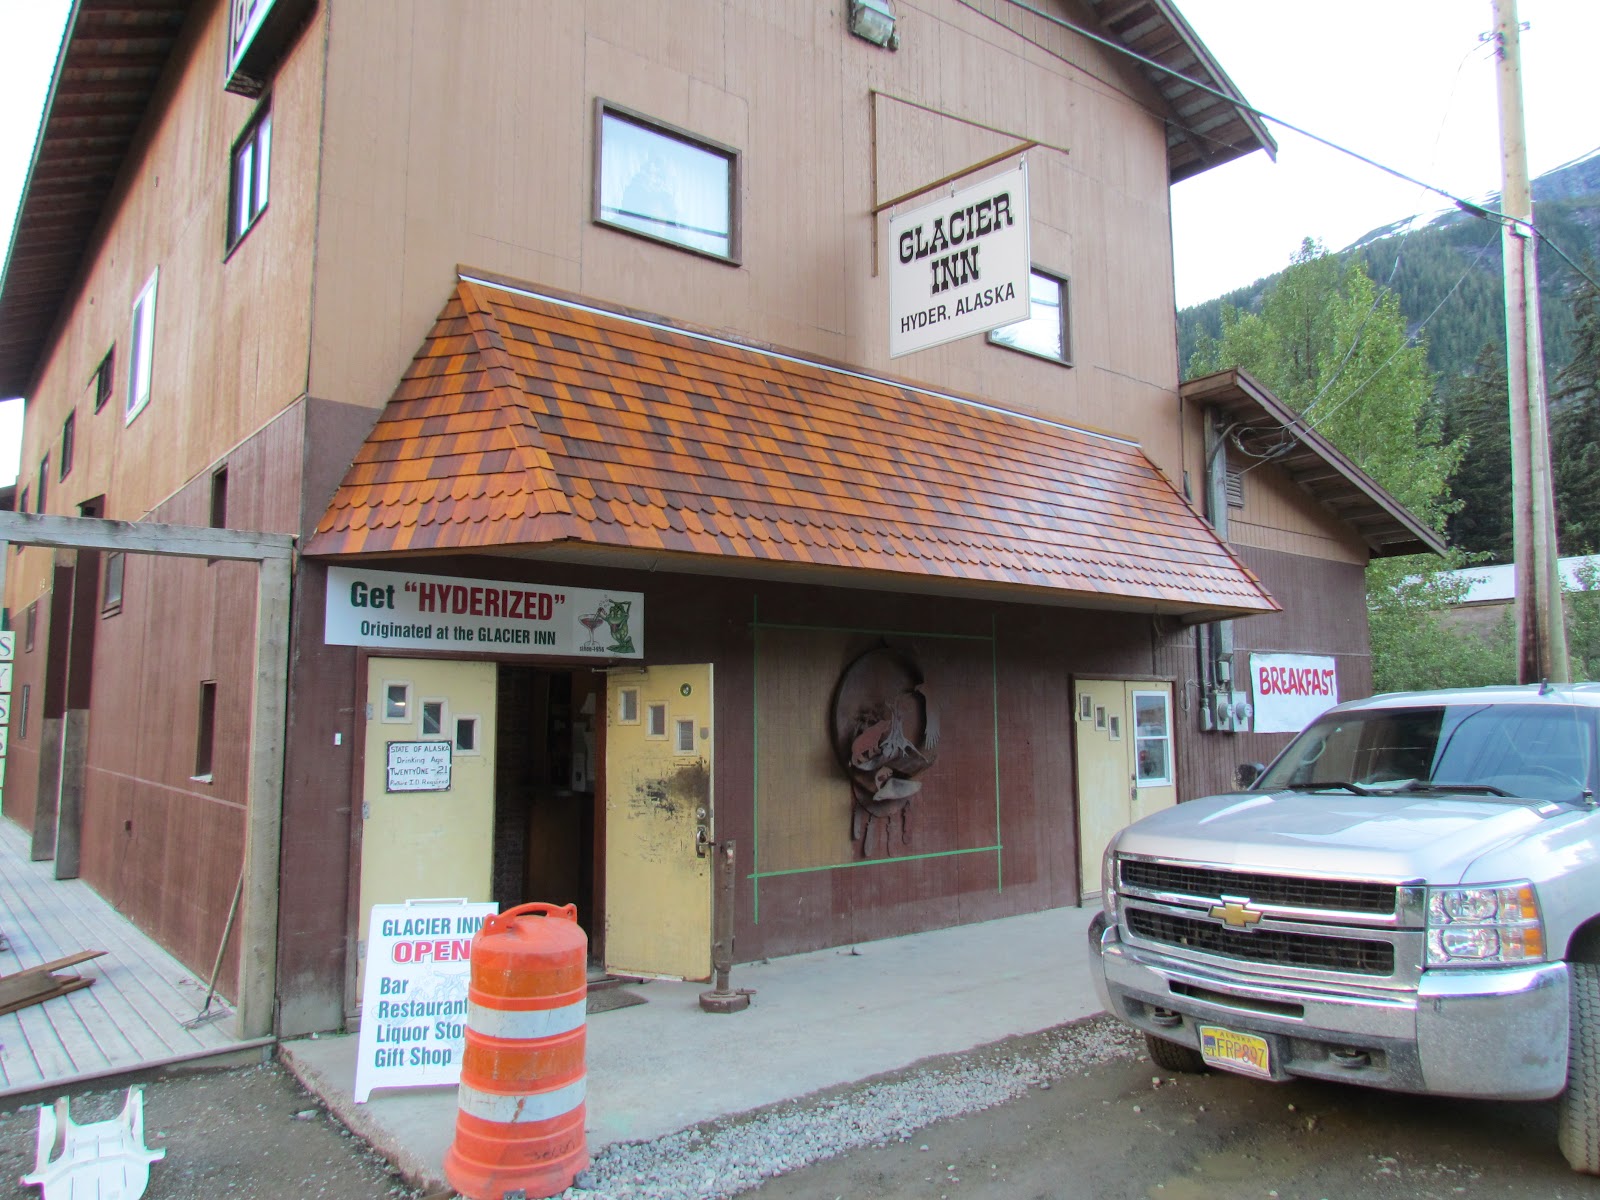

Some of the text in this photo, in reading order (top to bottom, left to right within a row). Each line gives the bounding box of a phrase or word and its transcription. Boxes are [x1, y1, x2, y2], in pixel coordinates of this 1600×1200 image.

[899, 192, 1013, 264] GLACIER
[931, 245, 980, 295] INN
[955, 282, 1016, 317] ALASKA
[350, 581, 396, 610] Get
[361, 620, 556, 645] Originated at the GLACIER INN
[1259, 666, 1334, 696] BREAKFAST
[390, 745, 450, 753] STATE OF ALASKA
[396, 756, 425, 764] Drinking
[382, 916, 485, 937] GLACIER INN
[393, 939, 471, 963] OPEN
[380, 976, 409, 995] Bar
[378, 997, 468, 1019] Restaurant
[376, 1023, 430, 1045] Liquor
[374, 1046, 452, 1068] Gift Shop
